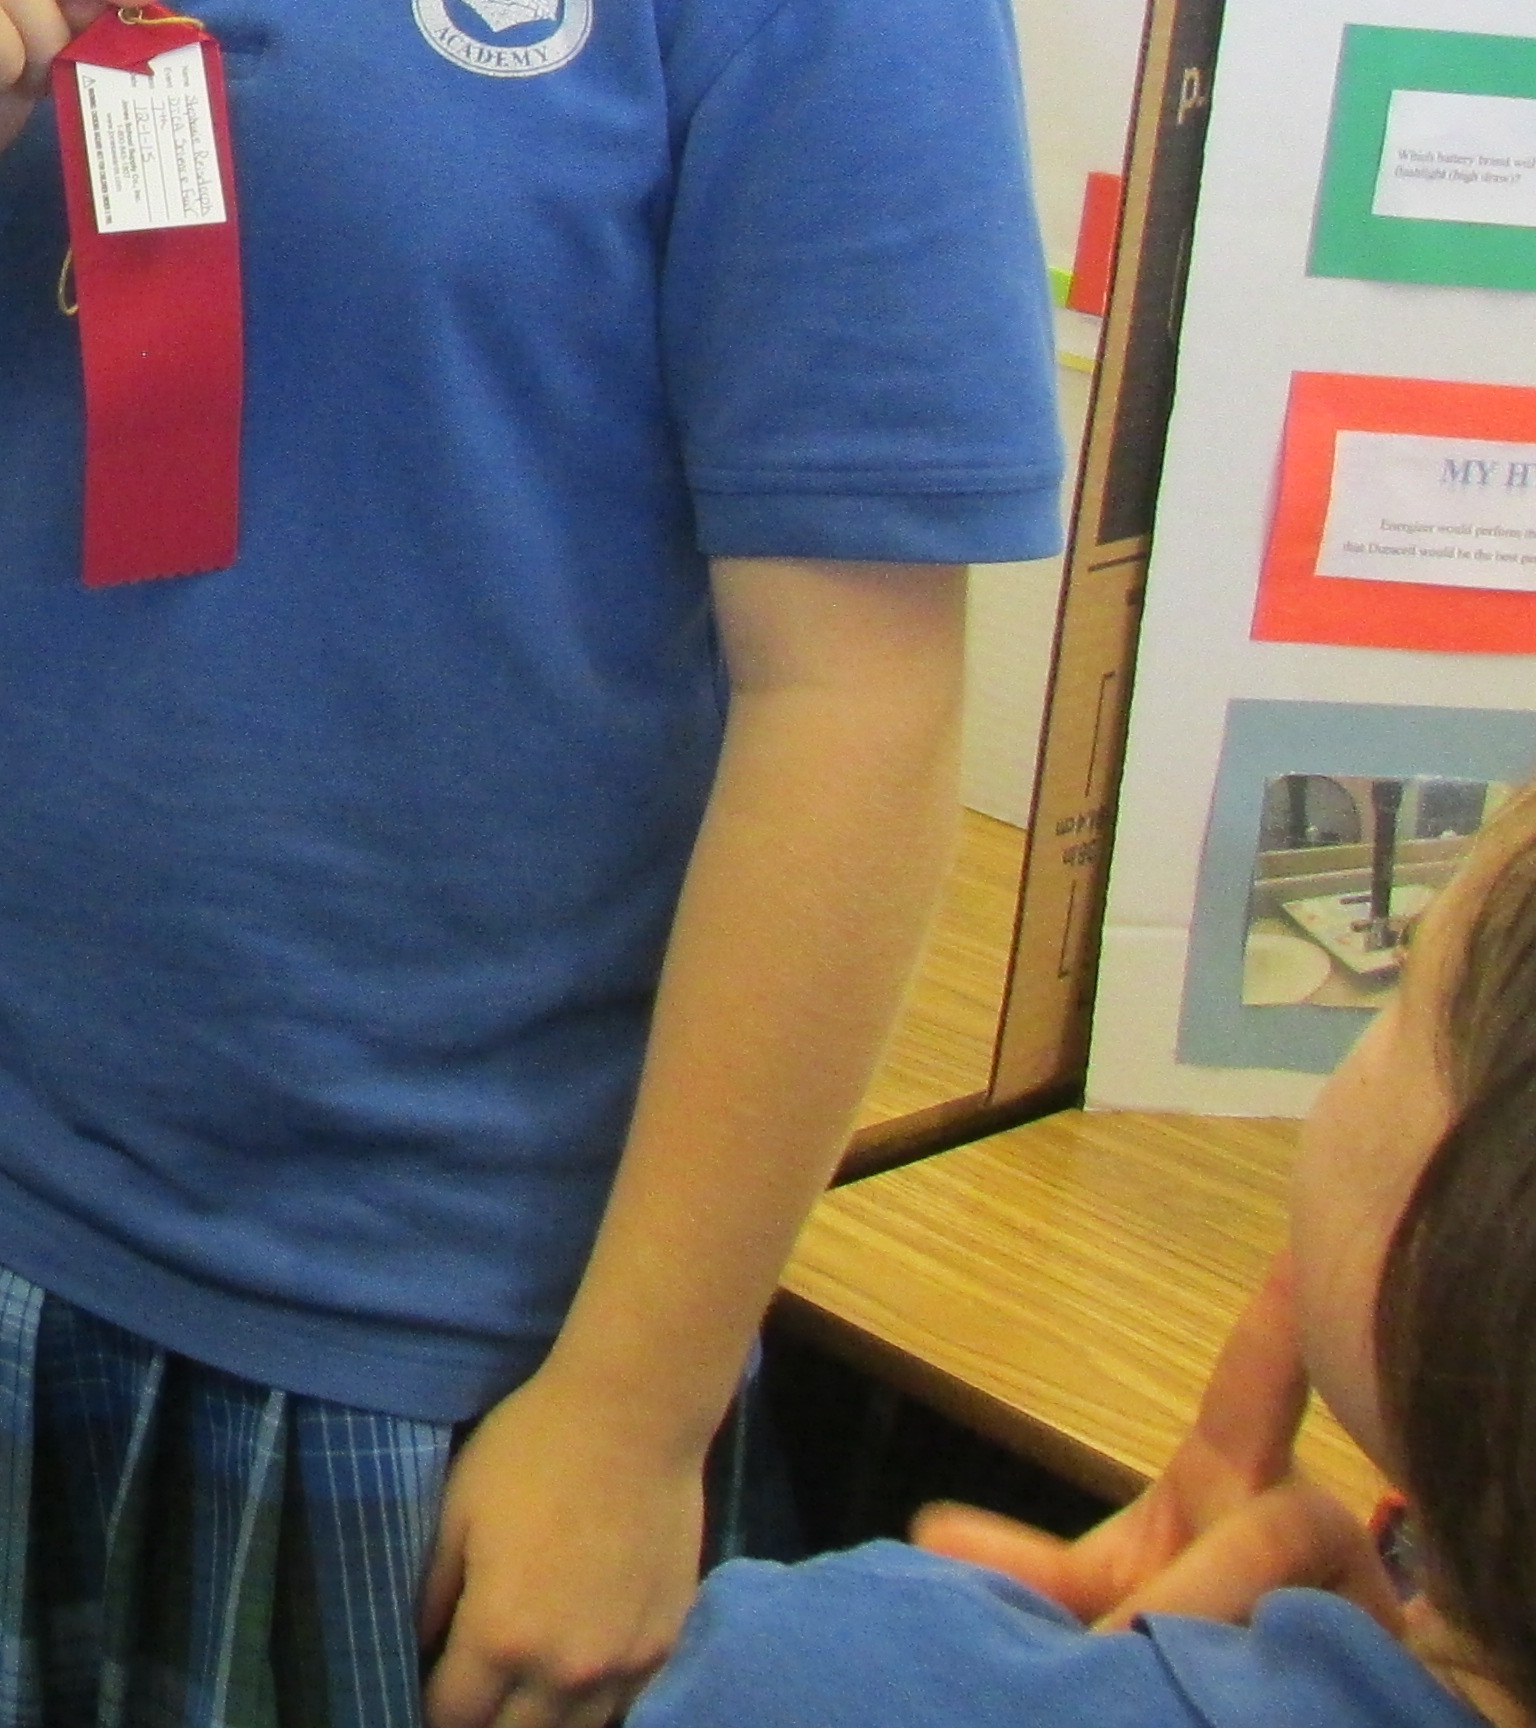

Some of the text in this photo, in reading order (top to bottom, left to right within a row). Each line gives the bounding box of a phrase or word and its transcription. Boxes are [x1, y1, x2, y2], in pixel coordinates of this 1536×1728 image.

[434, 25, 548, 68] ACADEMY
[121, 99, 130, 121] Jones
[124, 123, 133, 147] School
[126, 148, 137, 172] Supply
[1438, 151, 1473, 166] battery
[1479, 155, 1511, 167] brand
[1440, 458, 1497, 485] MY
[1380, 519, 1434, 534] Energizer
[1436, 525, 1472, 534] would
[1474, 526, 1521, 538] perform
[1343, 541, 1366, 553] that
[1368, 543, 1416, 555] Duracell
[1419, 547, 1455, 559] would
[1458, 549, 1473, 559] be
[1475, 549, 1494, 560] the
[1496, 552, 1518, 562] best
